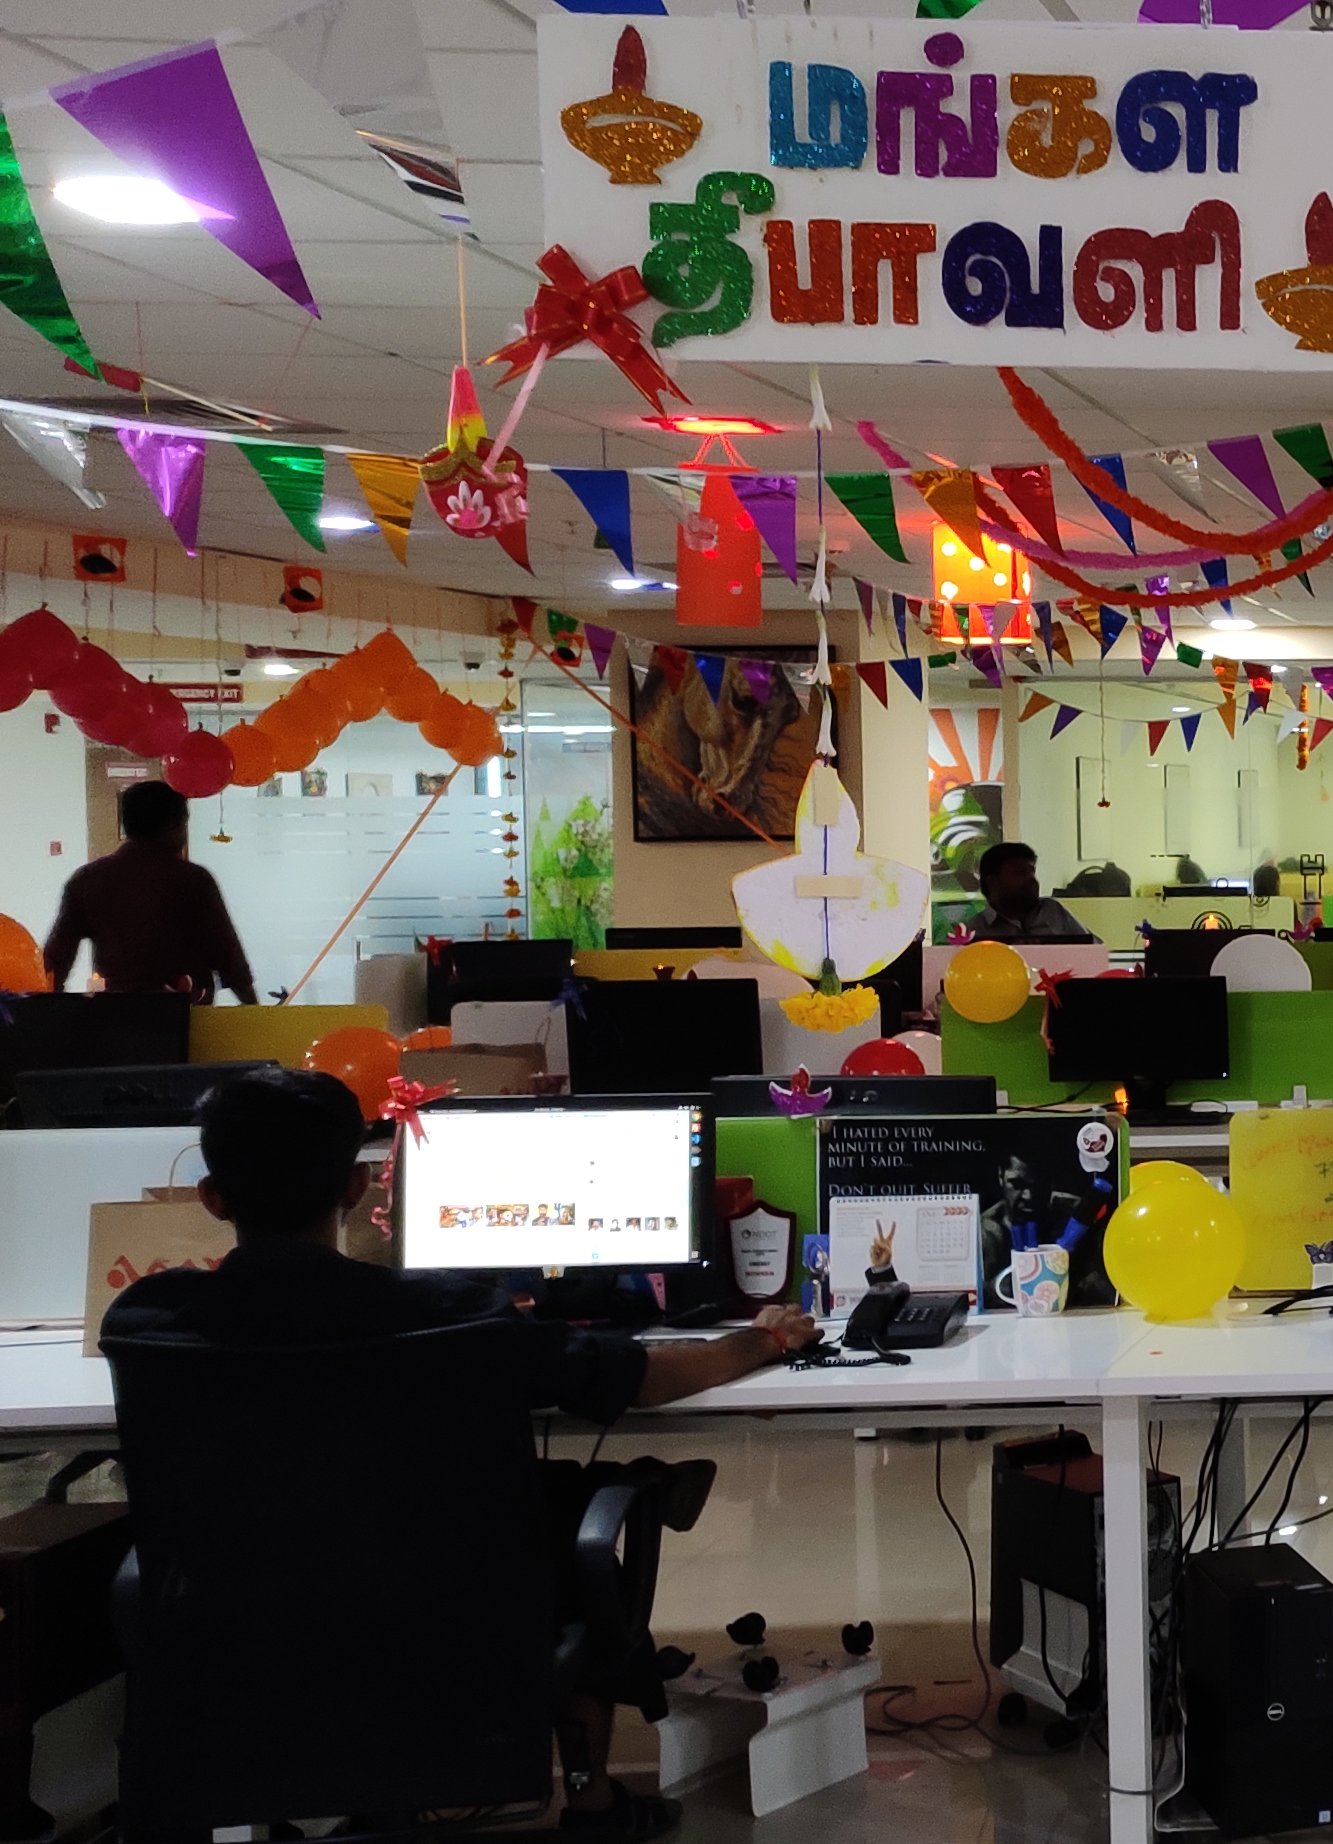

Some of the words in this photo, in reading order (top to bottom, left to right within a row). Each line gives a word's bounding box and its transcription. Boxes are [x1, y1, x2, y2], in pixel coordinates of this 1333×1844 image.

[768, 31, 1259, 180] மங்கள
[641, 170, 1243, 348] தீபாவளி
[832, 1125, 838, 1139] I
[843, 1126, 889, 1139] HATED
[894, 1126, 935, 1139] EVERY
[828, 1141, 884, 1154] MINUTE
[888, 1141, 907, 1153] OF
[828, 1155, 855, 1169] BUT
[860, 1154, 866, 1168] I
